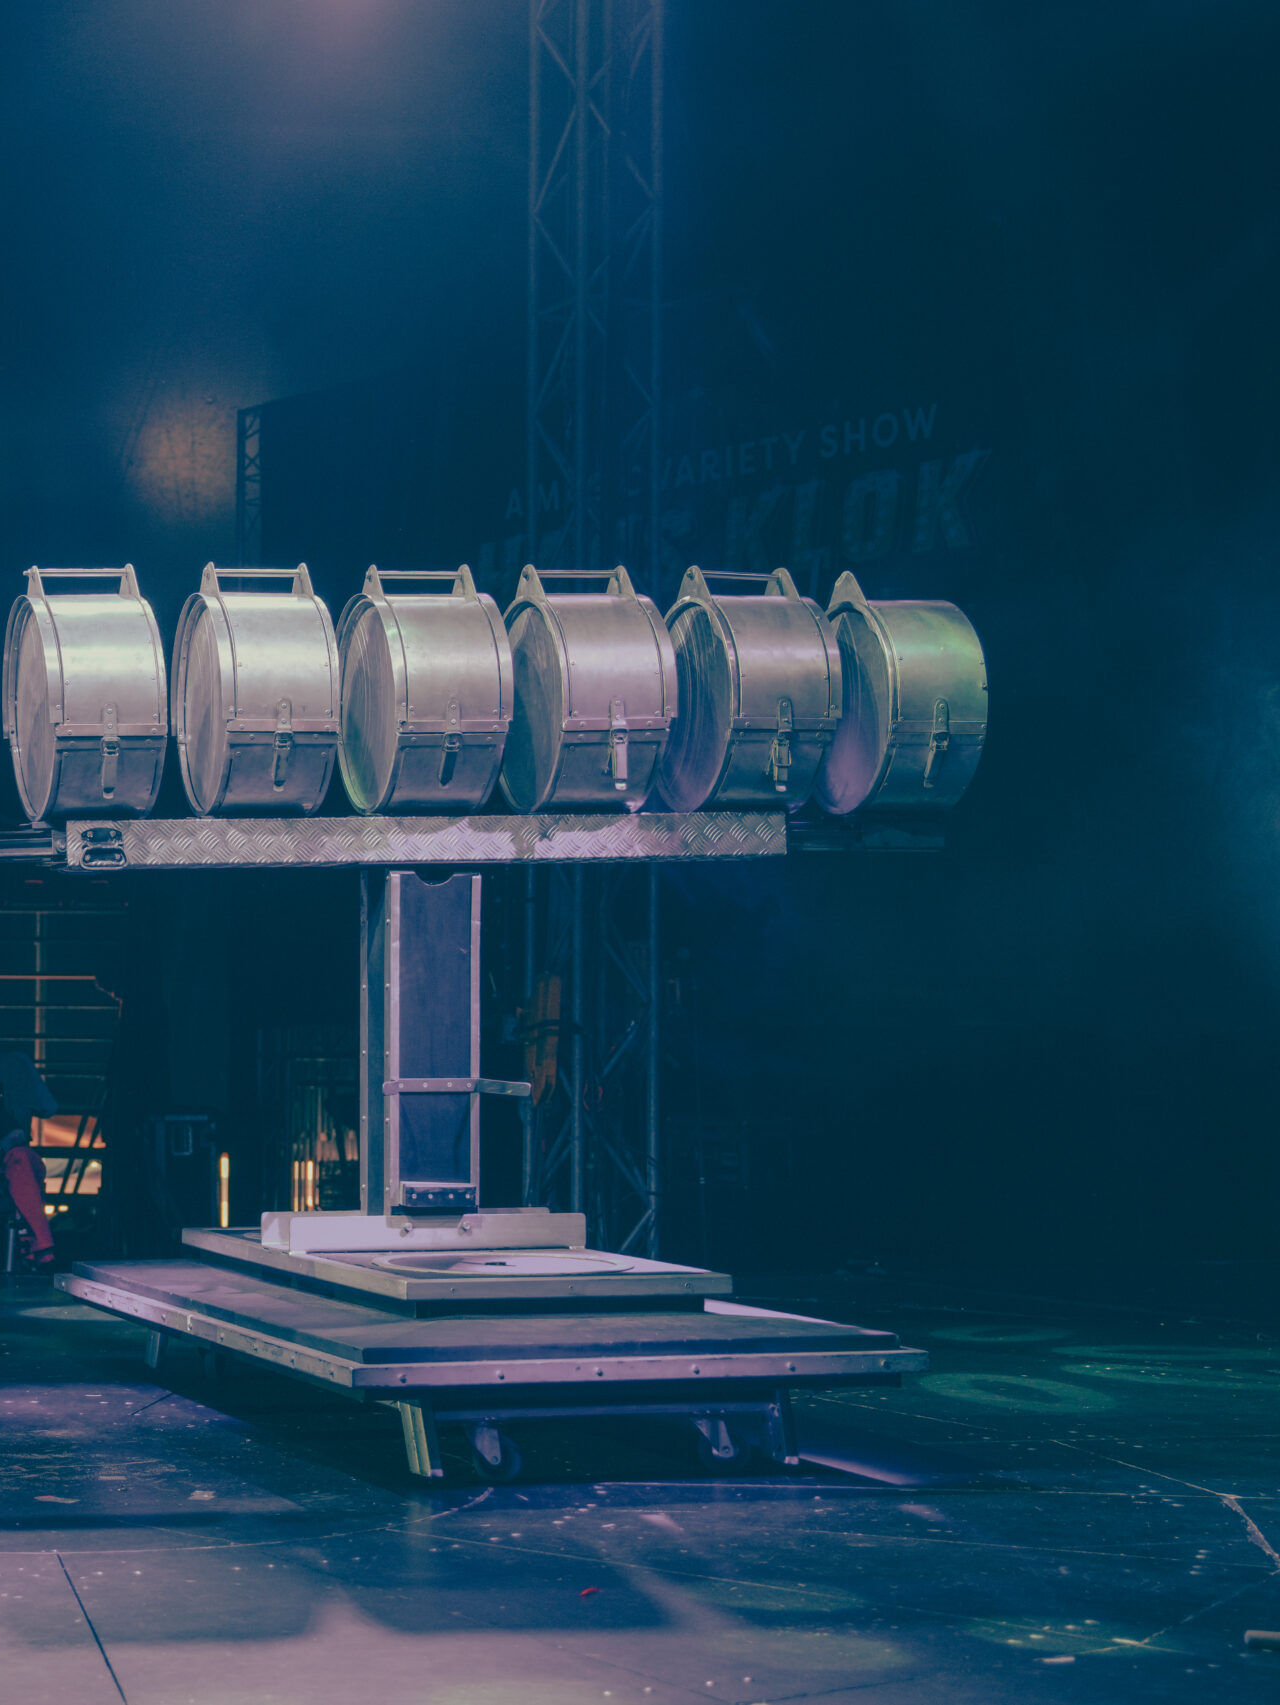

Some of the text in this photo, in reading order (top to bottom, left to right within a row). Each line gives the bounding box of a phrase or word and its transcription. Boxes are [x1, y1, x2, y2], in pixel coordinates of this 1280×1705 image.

[537, 463, 651, 514] MGC
[656, 430, 807, 489] VARIETY
[820, 402, 939, 459] SHOW
[723, 447, 993, 573] KLOK
